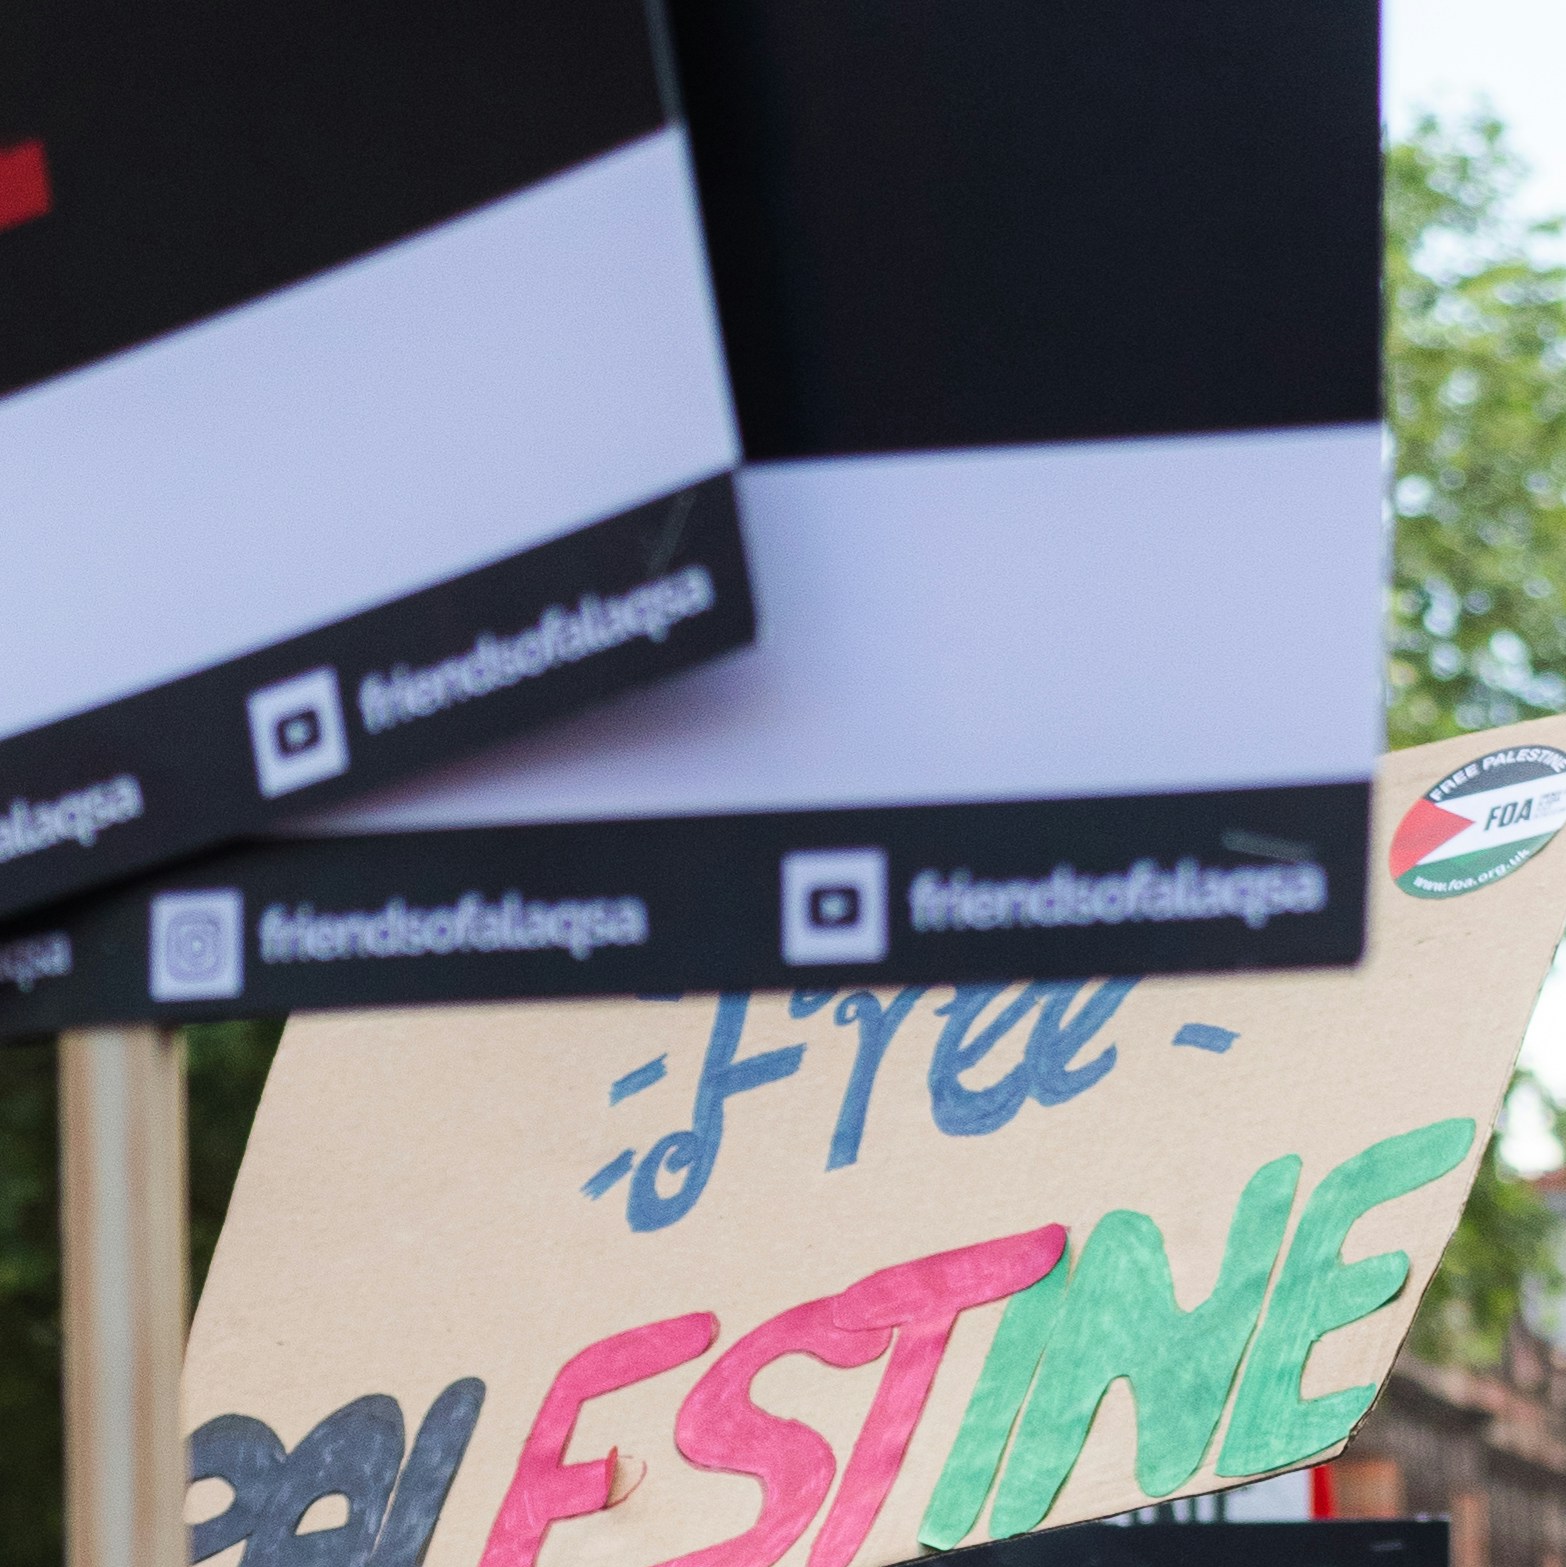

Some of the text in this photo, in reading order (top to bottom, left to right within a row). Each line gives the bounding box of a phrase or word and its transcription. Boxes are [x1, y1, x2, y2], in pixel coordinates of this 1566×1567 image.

[1429, 761, 1481, 802] FREE
[1484, 798, 1534, 832] FOA
[1413, 849, 1531, 893] www.foa.org.uk
